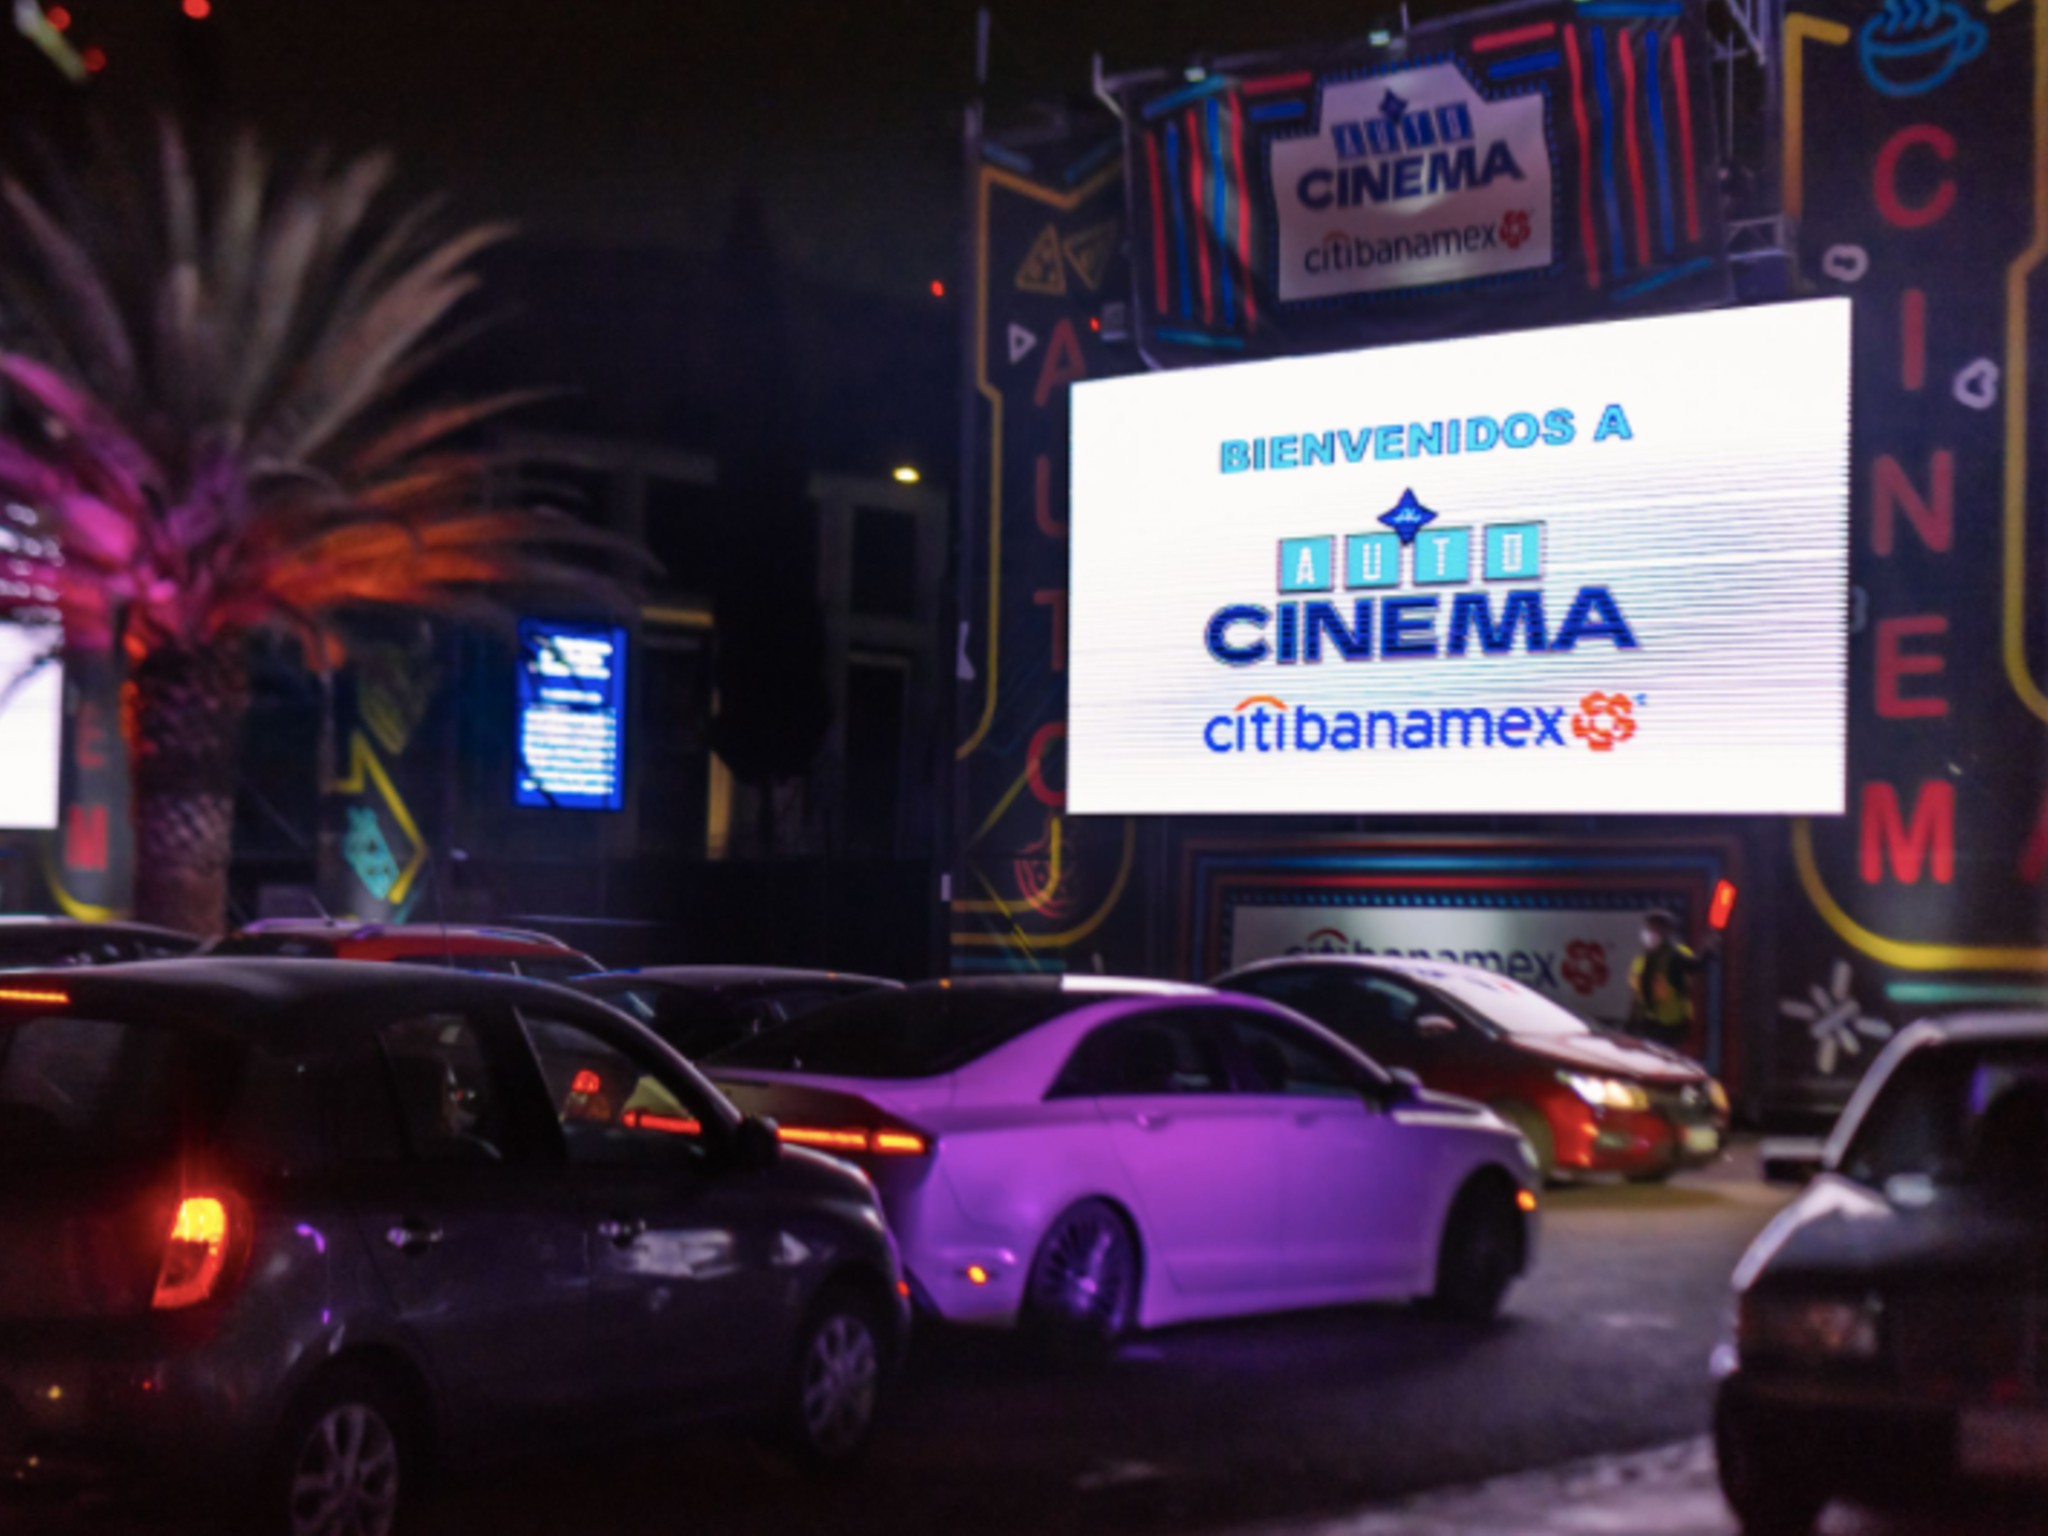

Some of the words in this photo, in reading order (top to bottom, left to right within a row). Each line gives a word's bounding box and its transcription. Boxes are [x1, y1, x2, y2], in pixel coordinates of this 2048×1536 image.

[1297, 138, 1526, 210] CINEMA
[1303, 222, 1498, 275] citibanamex
[1219, 408, 1576, 474] BIENVENIDOS
[1593, 403, 1633, 443] A
[1294, 532, 1524, 586] AUTO
[1204, 584, 1641, 668] CINEMA
[1203, 695, 1568, 753] citibanamex
